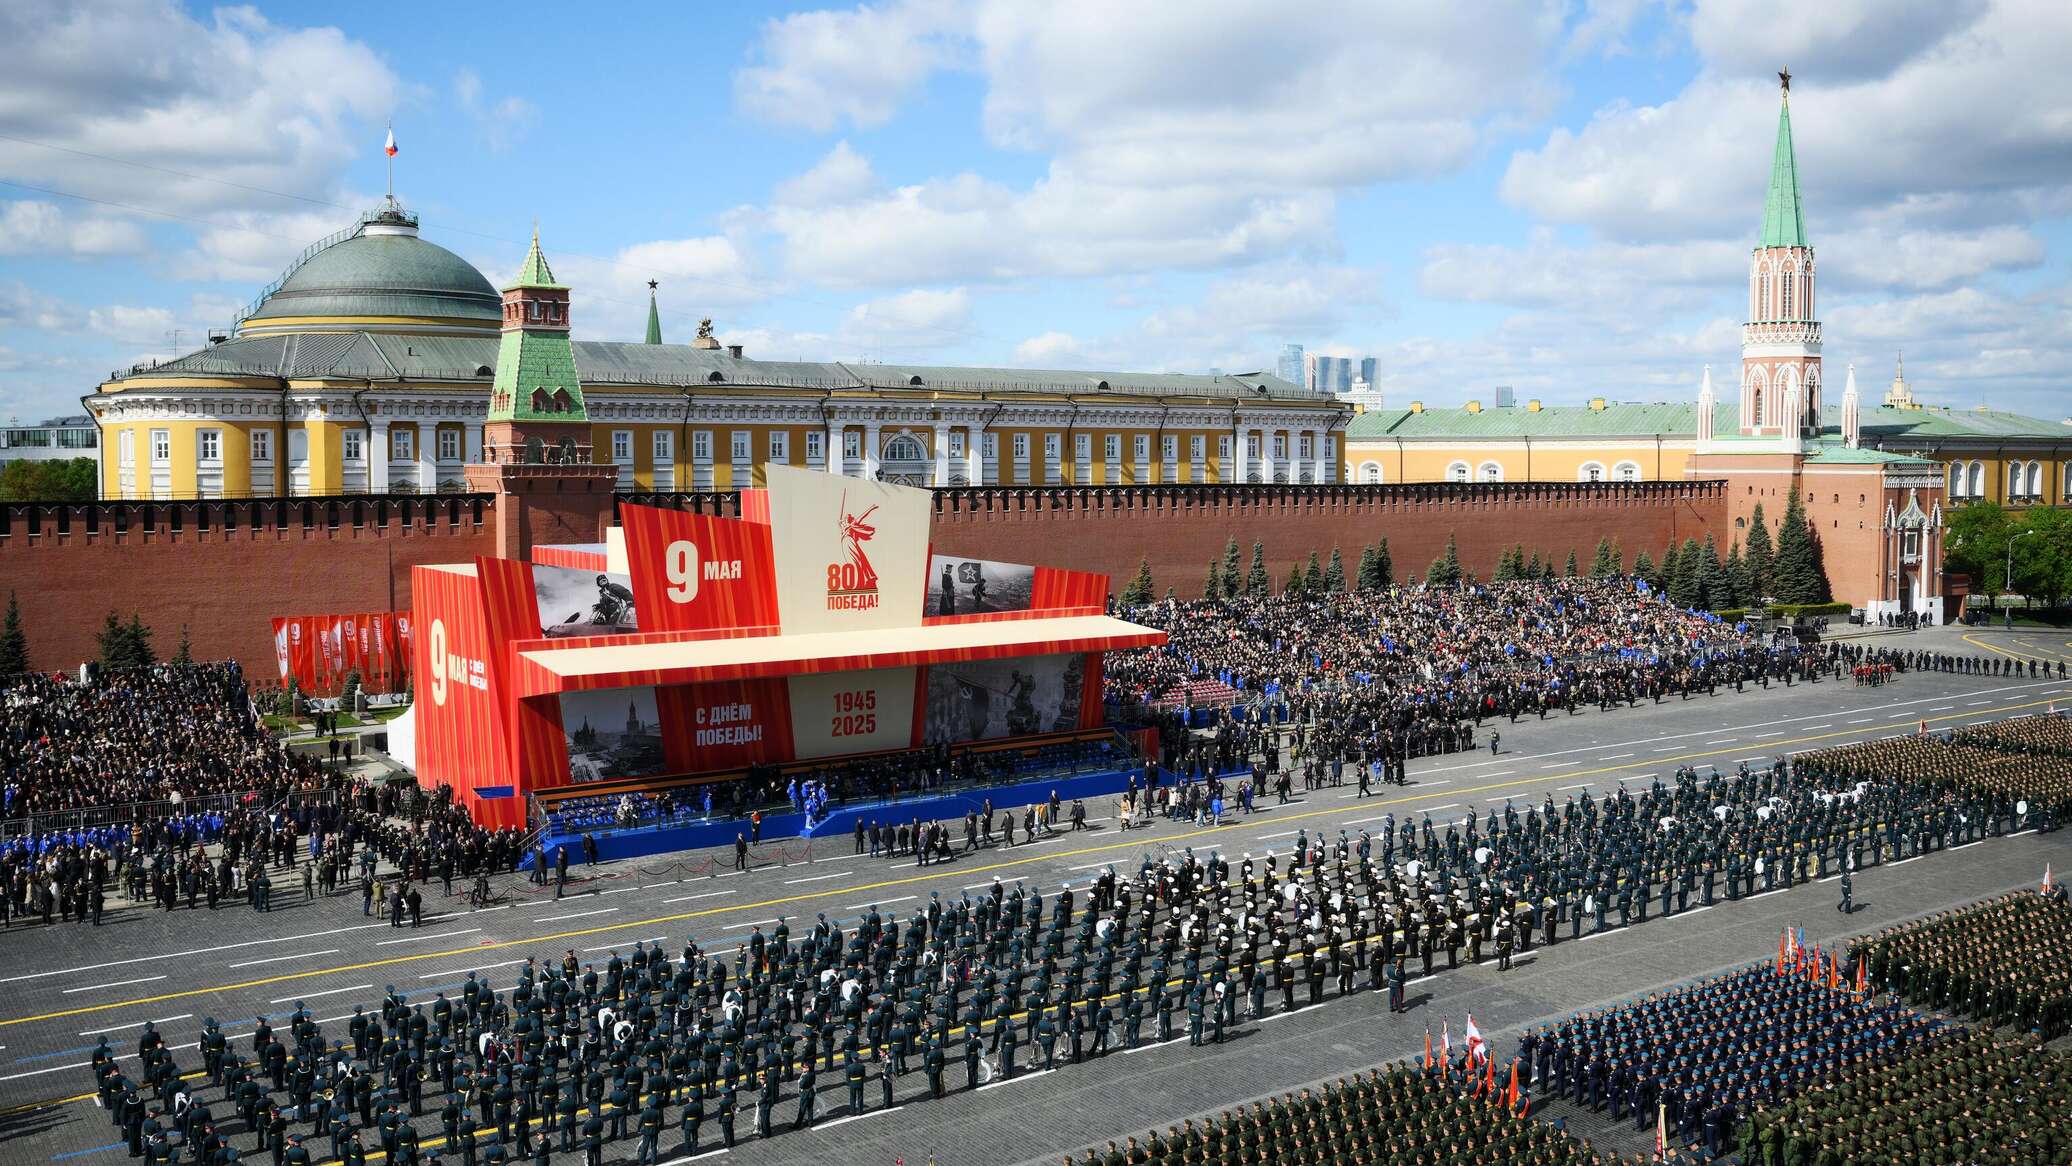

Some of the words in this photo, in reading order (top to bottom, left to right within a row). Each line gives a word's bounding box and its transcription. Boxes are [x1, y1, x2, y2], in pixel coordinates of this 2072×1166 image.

[666, 540, 698, 604] 9
[704, 560, 742, 580] МАЯ
[827, 563, 856, 591] 80
[827, 594, 879, 611] ПОБЕДА!
[431, 618, 447, 707] 9
[448, 652, 468, 685] МАЯ
[833, 689, 876, 713] 1945
[696, 707, 706, 725] С
[710, 702, 752, 726] ДНЁМ
[831, 713, 876, 738] 2025
[696, 724, 763, 747] ПОБЕДЫ!
